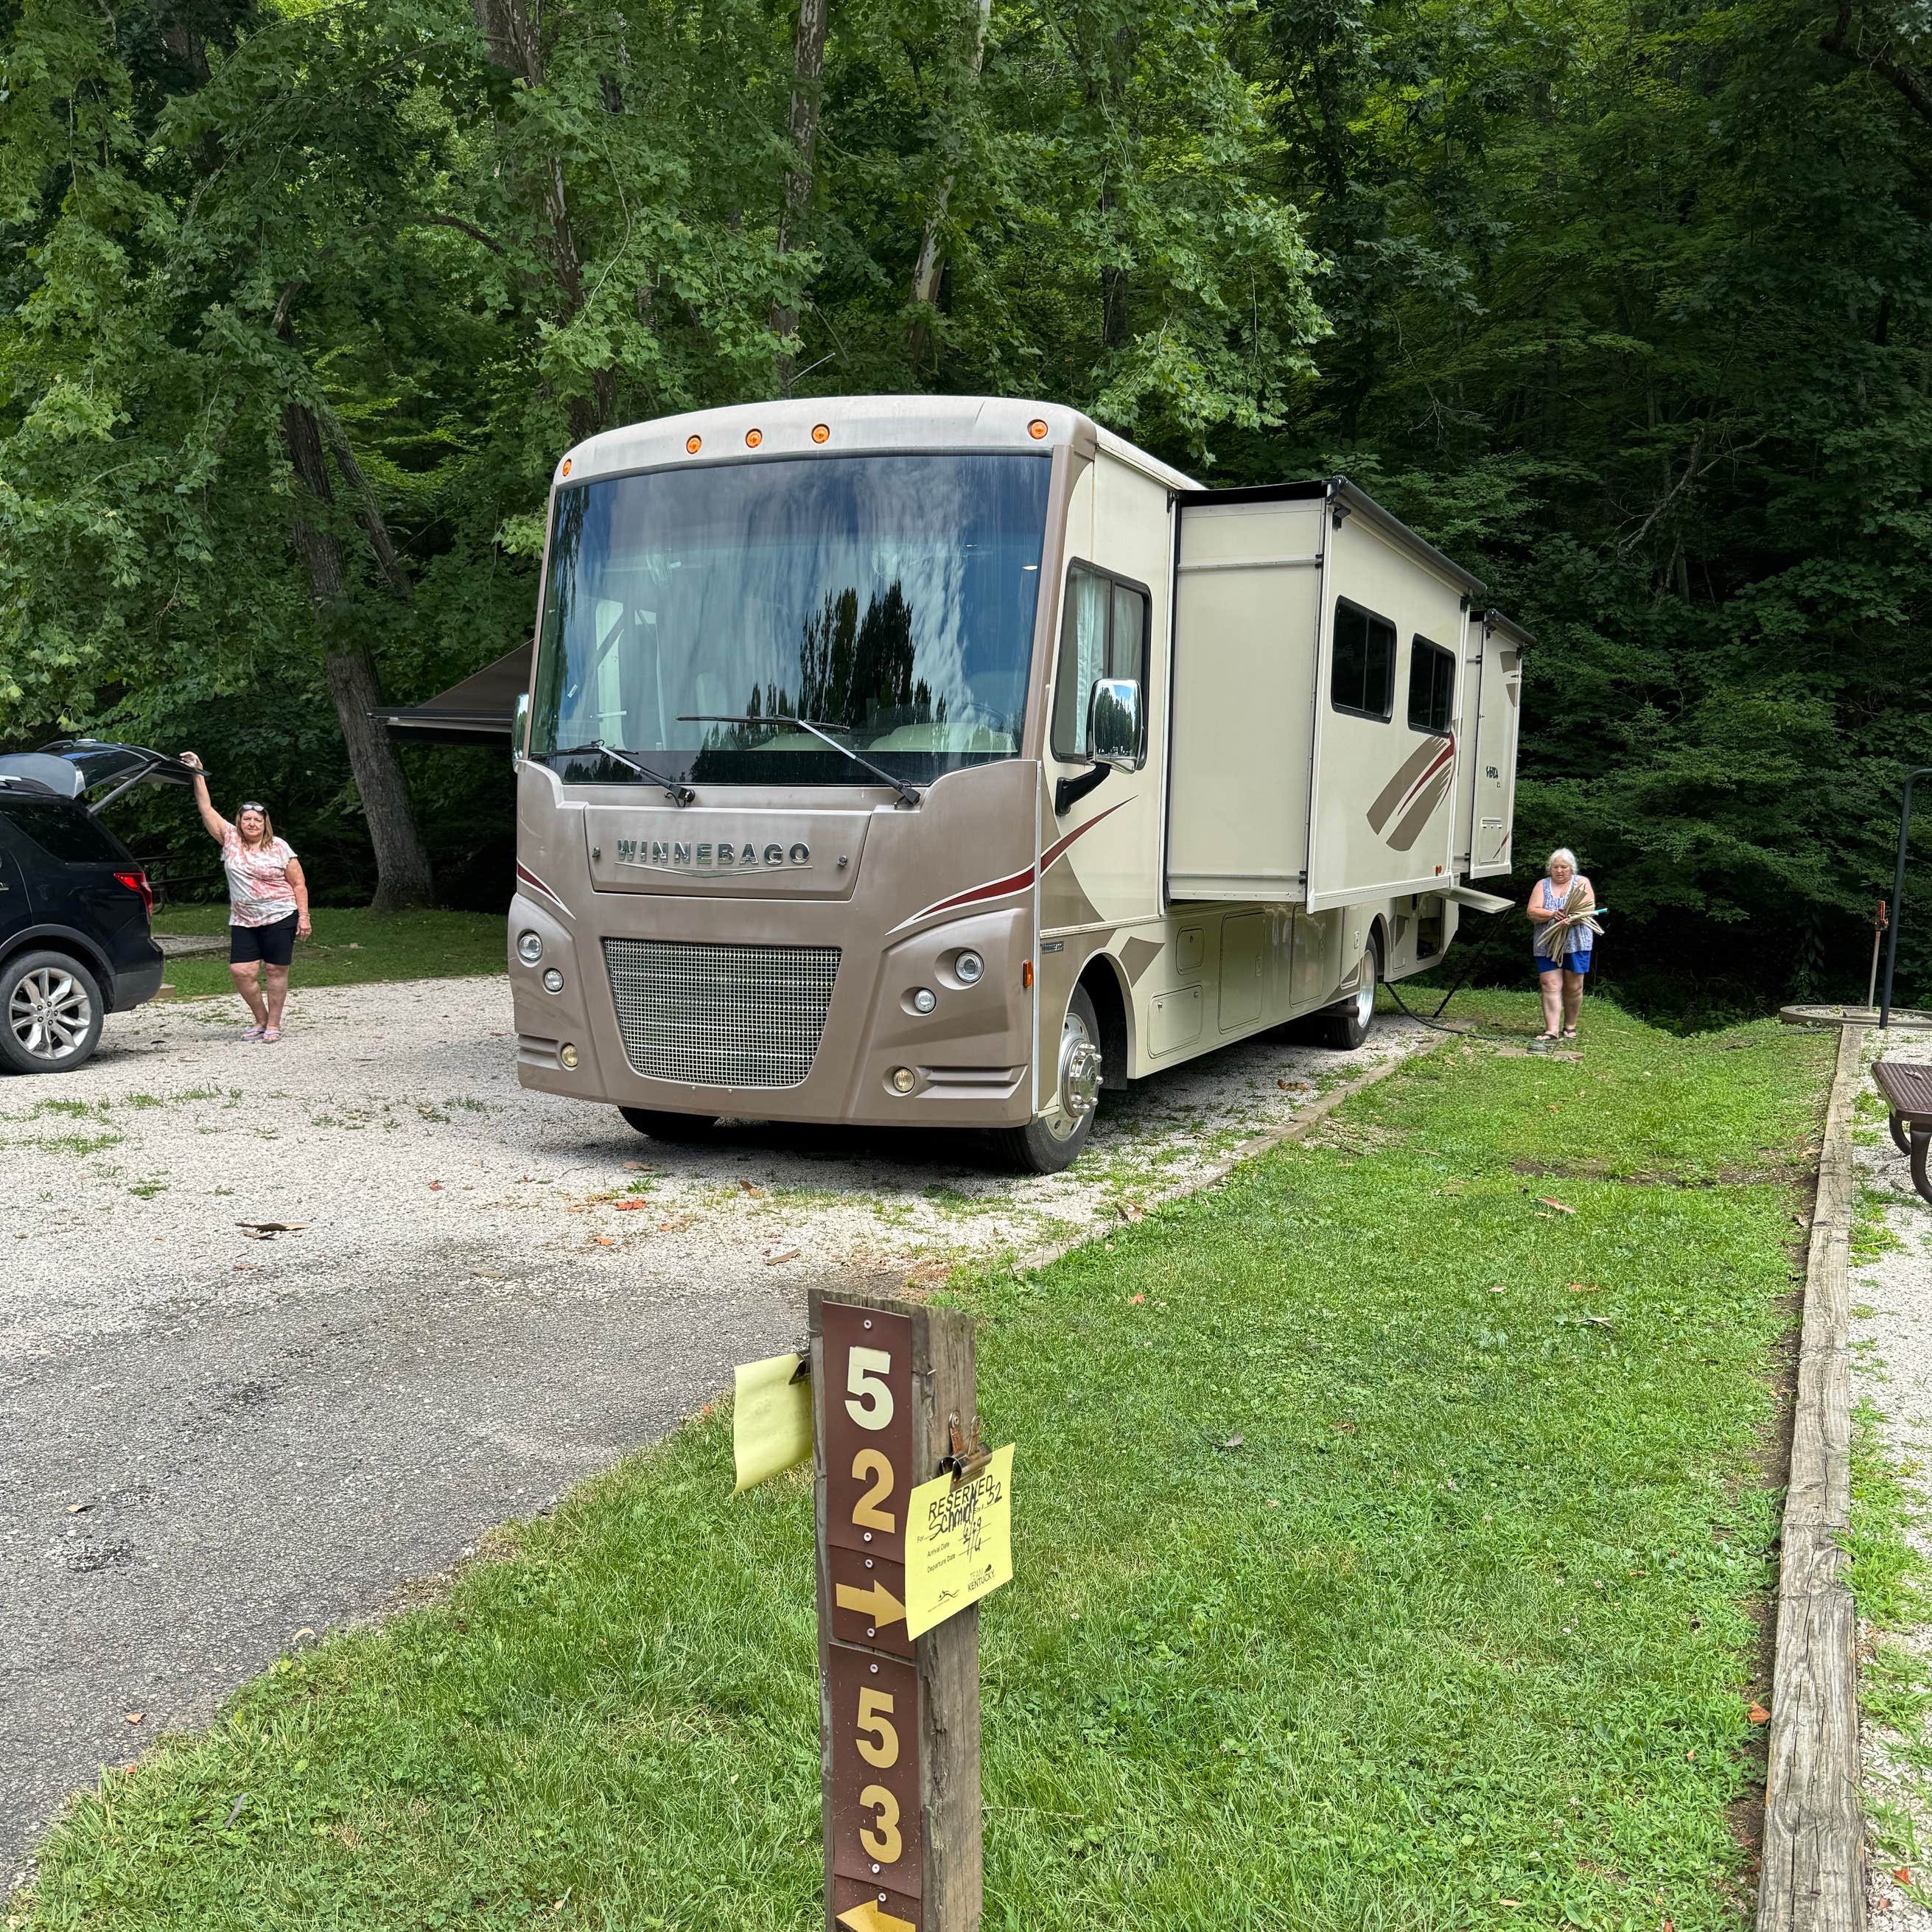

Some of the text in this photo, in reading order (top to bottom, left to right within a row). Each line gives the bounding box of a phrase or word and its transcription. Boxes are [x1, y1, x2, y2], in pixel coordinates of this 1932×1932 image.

[617, 839, 811, 865] WINNEBAGO
[928, 1474, 993, 1522] RESERVED
[987, 1481, 1003, 1505] 52
[967, 1569, 995, 1592] KENTUCKY
